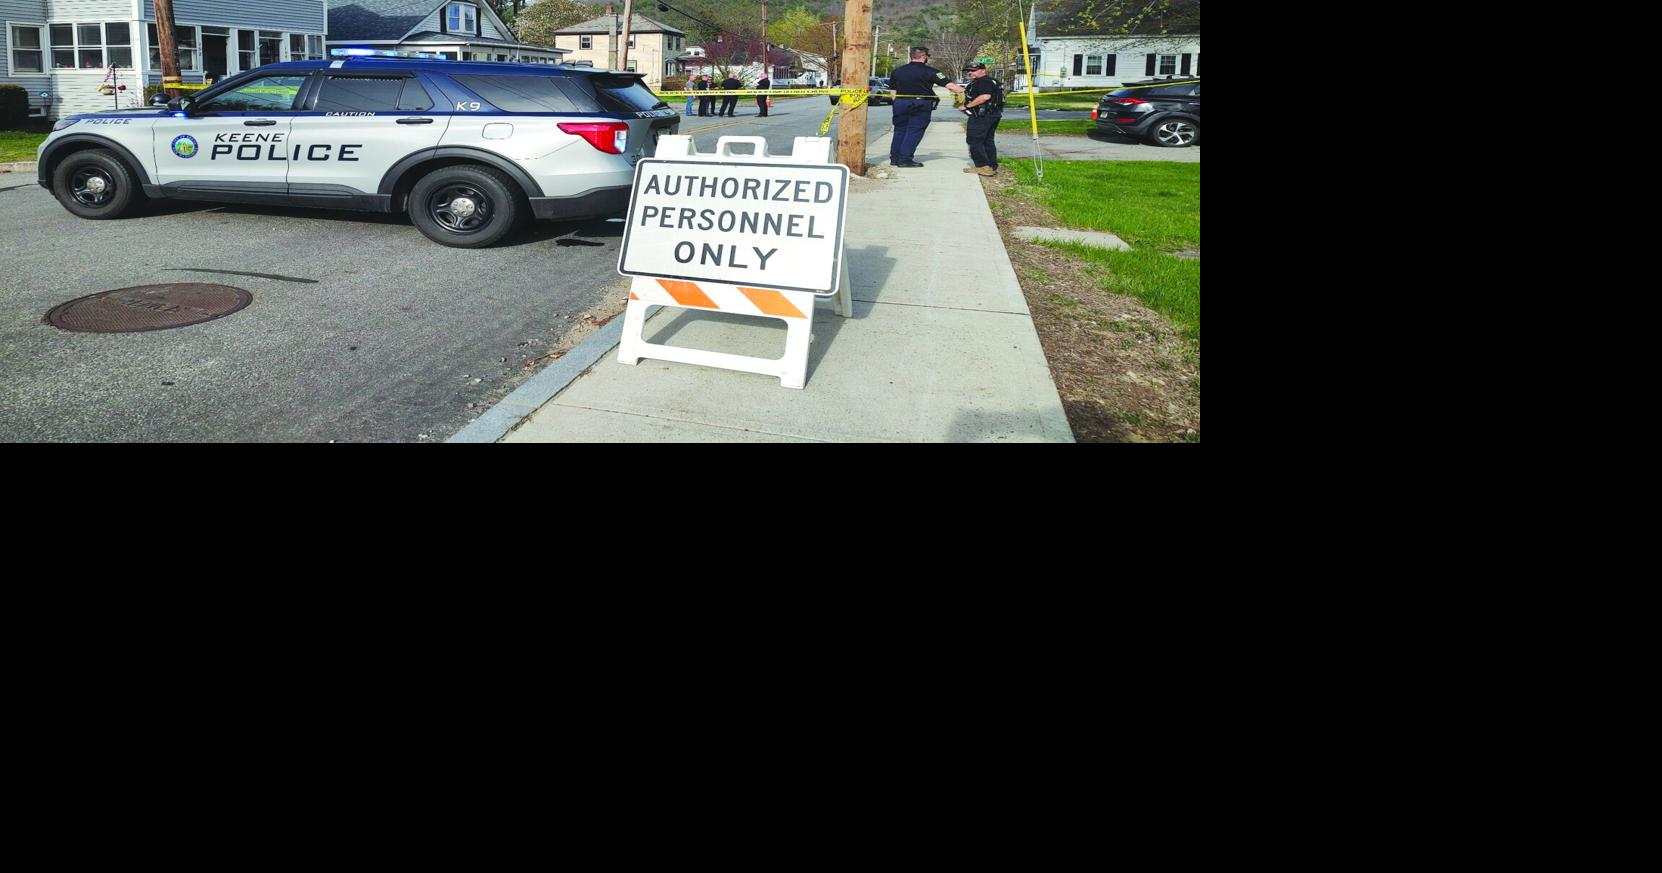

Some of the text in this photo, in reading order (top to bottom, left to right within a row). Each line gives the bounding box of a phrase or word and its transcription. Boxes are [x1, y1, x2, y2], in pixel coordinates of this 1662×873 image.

[635, 109, 675, 118] POL
[214, 133, 285, 143] KEENE
[211, 144, 363, 162] POLICE
[643, 174, 834, 204] AUTHORIZED
[640, 205, 825, 239] PERSONNEL
[674, 240, 778, 271] ONLY
